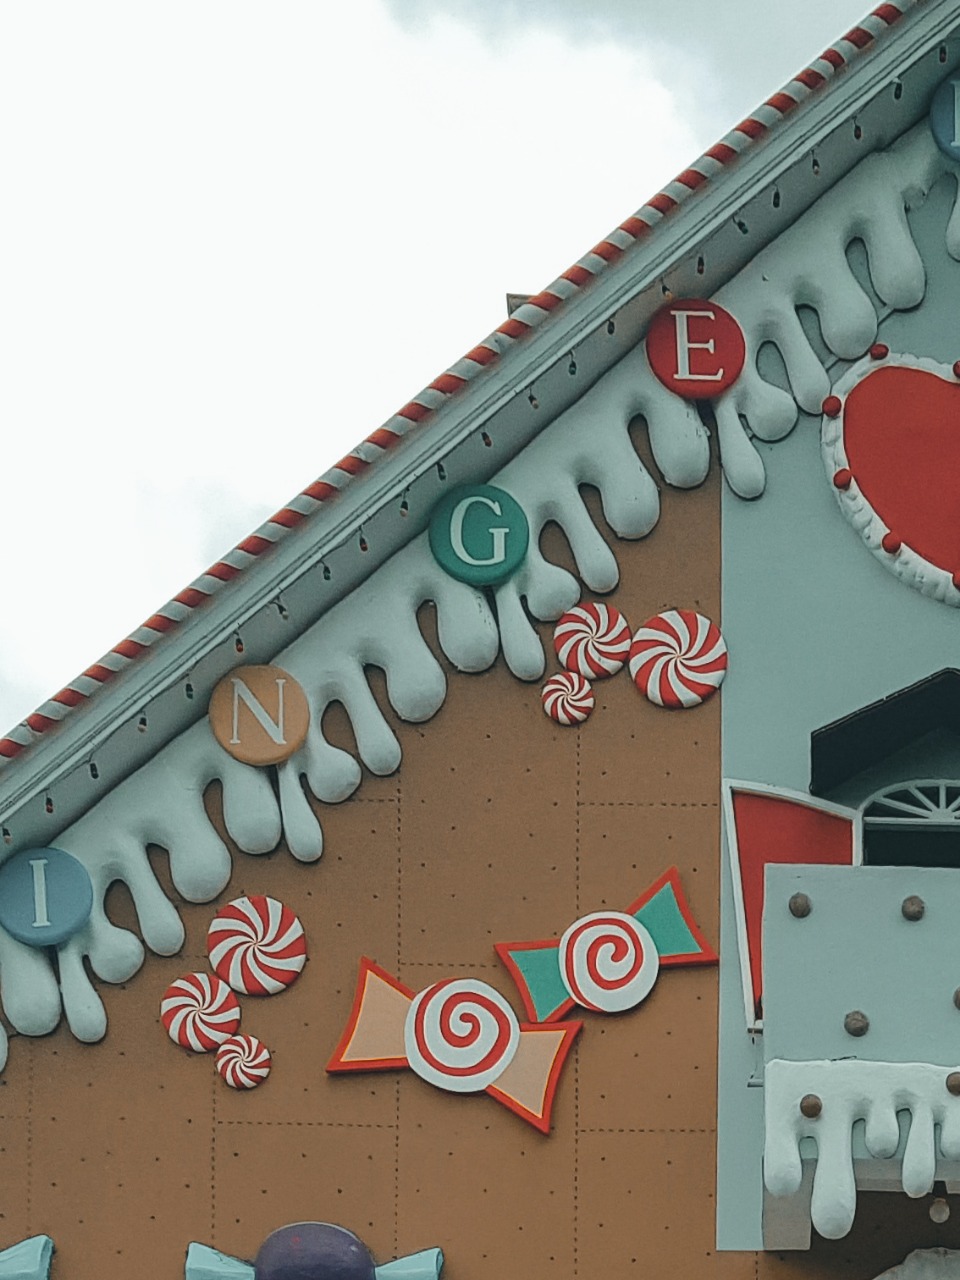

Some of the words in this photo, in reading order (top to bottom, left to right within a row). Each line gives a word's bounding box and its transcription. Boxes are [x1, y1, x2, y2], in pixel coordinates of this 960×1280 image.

[229, 678, 287, 745] N
[450, 496, 510, 566] G
[670, 310, 724, 382] E
